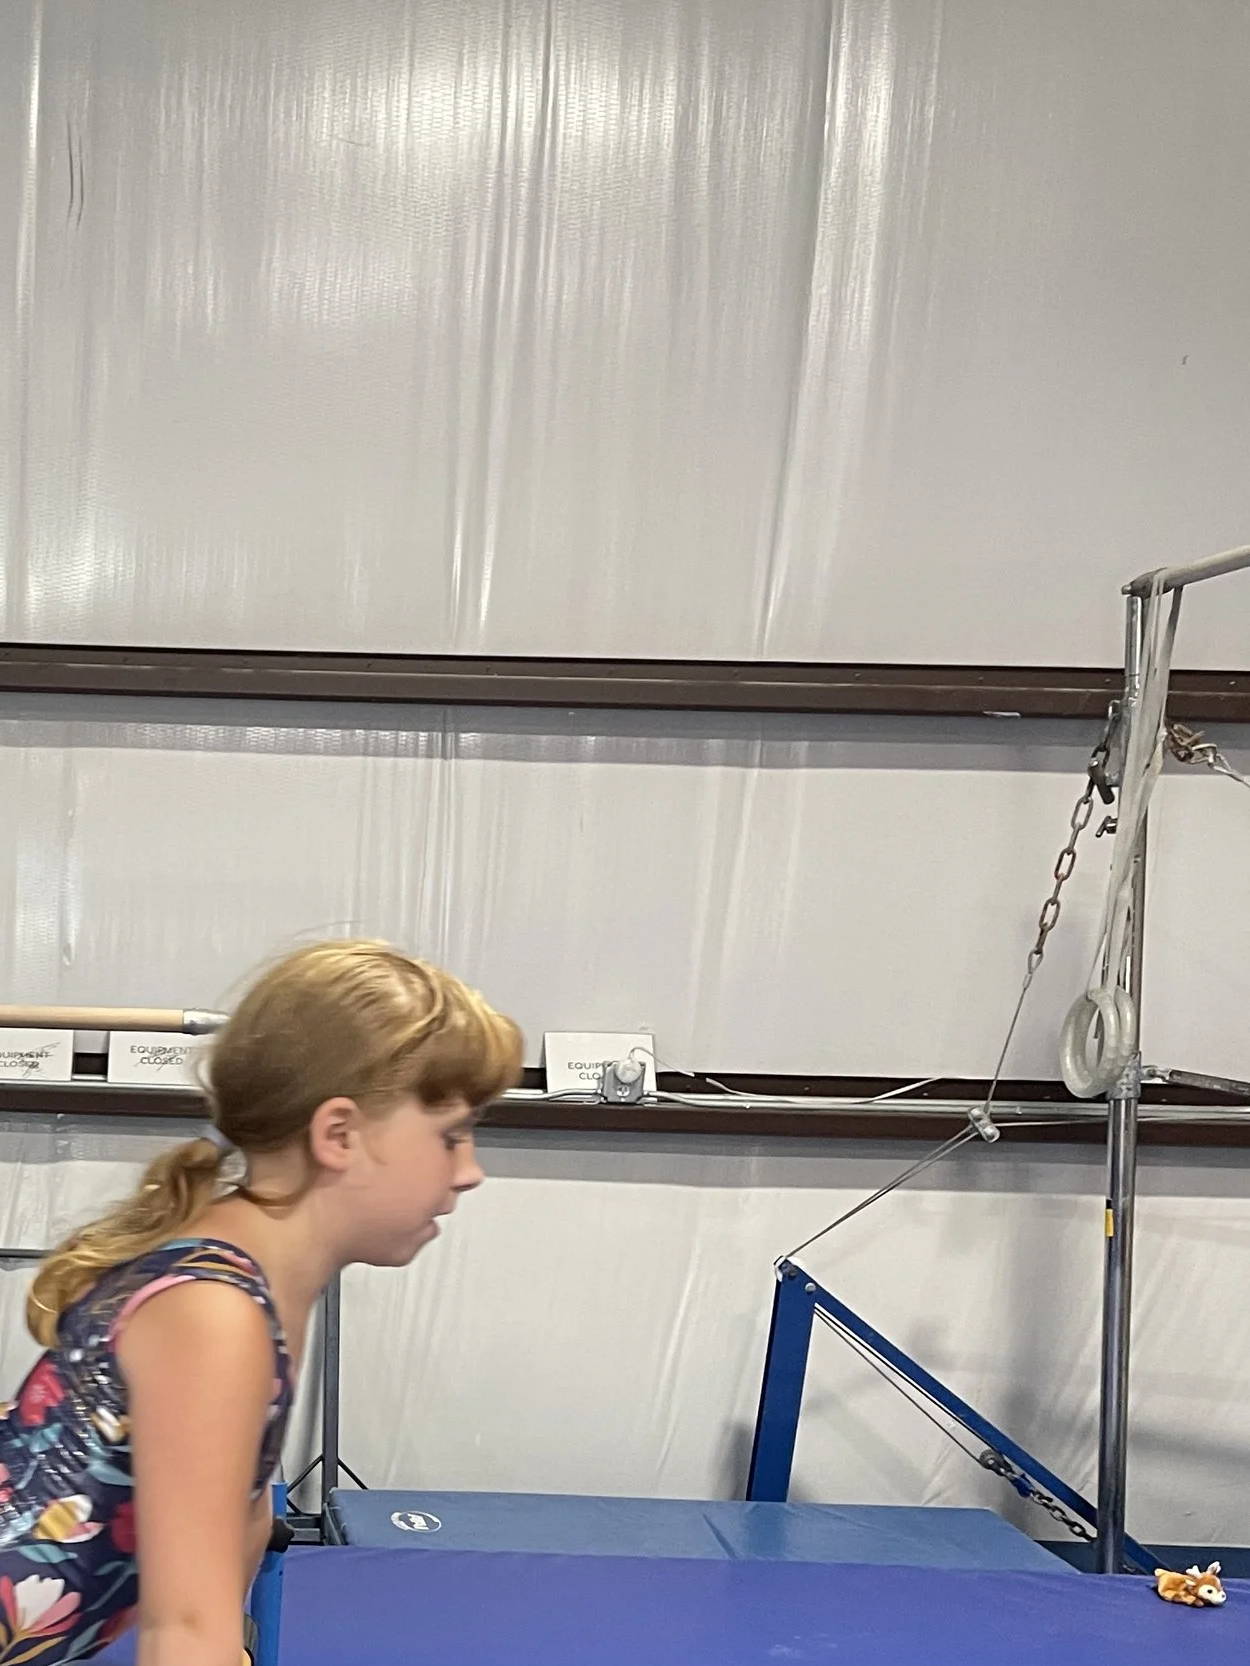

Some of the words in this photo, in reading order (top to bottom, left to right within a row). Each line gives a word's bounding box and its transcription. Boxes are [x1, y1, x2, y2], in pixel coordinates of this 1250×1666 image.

[140, 1056, 184, 1066] CLOSED
[567, 1061, 603, 1070] EQUIP
[578, 1072, 602, 1080] CLO
